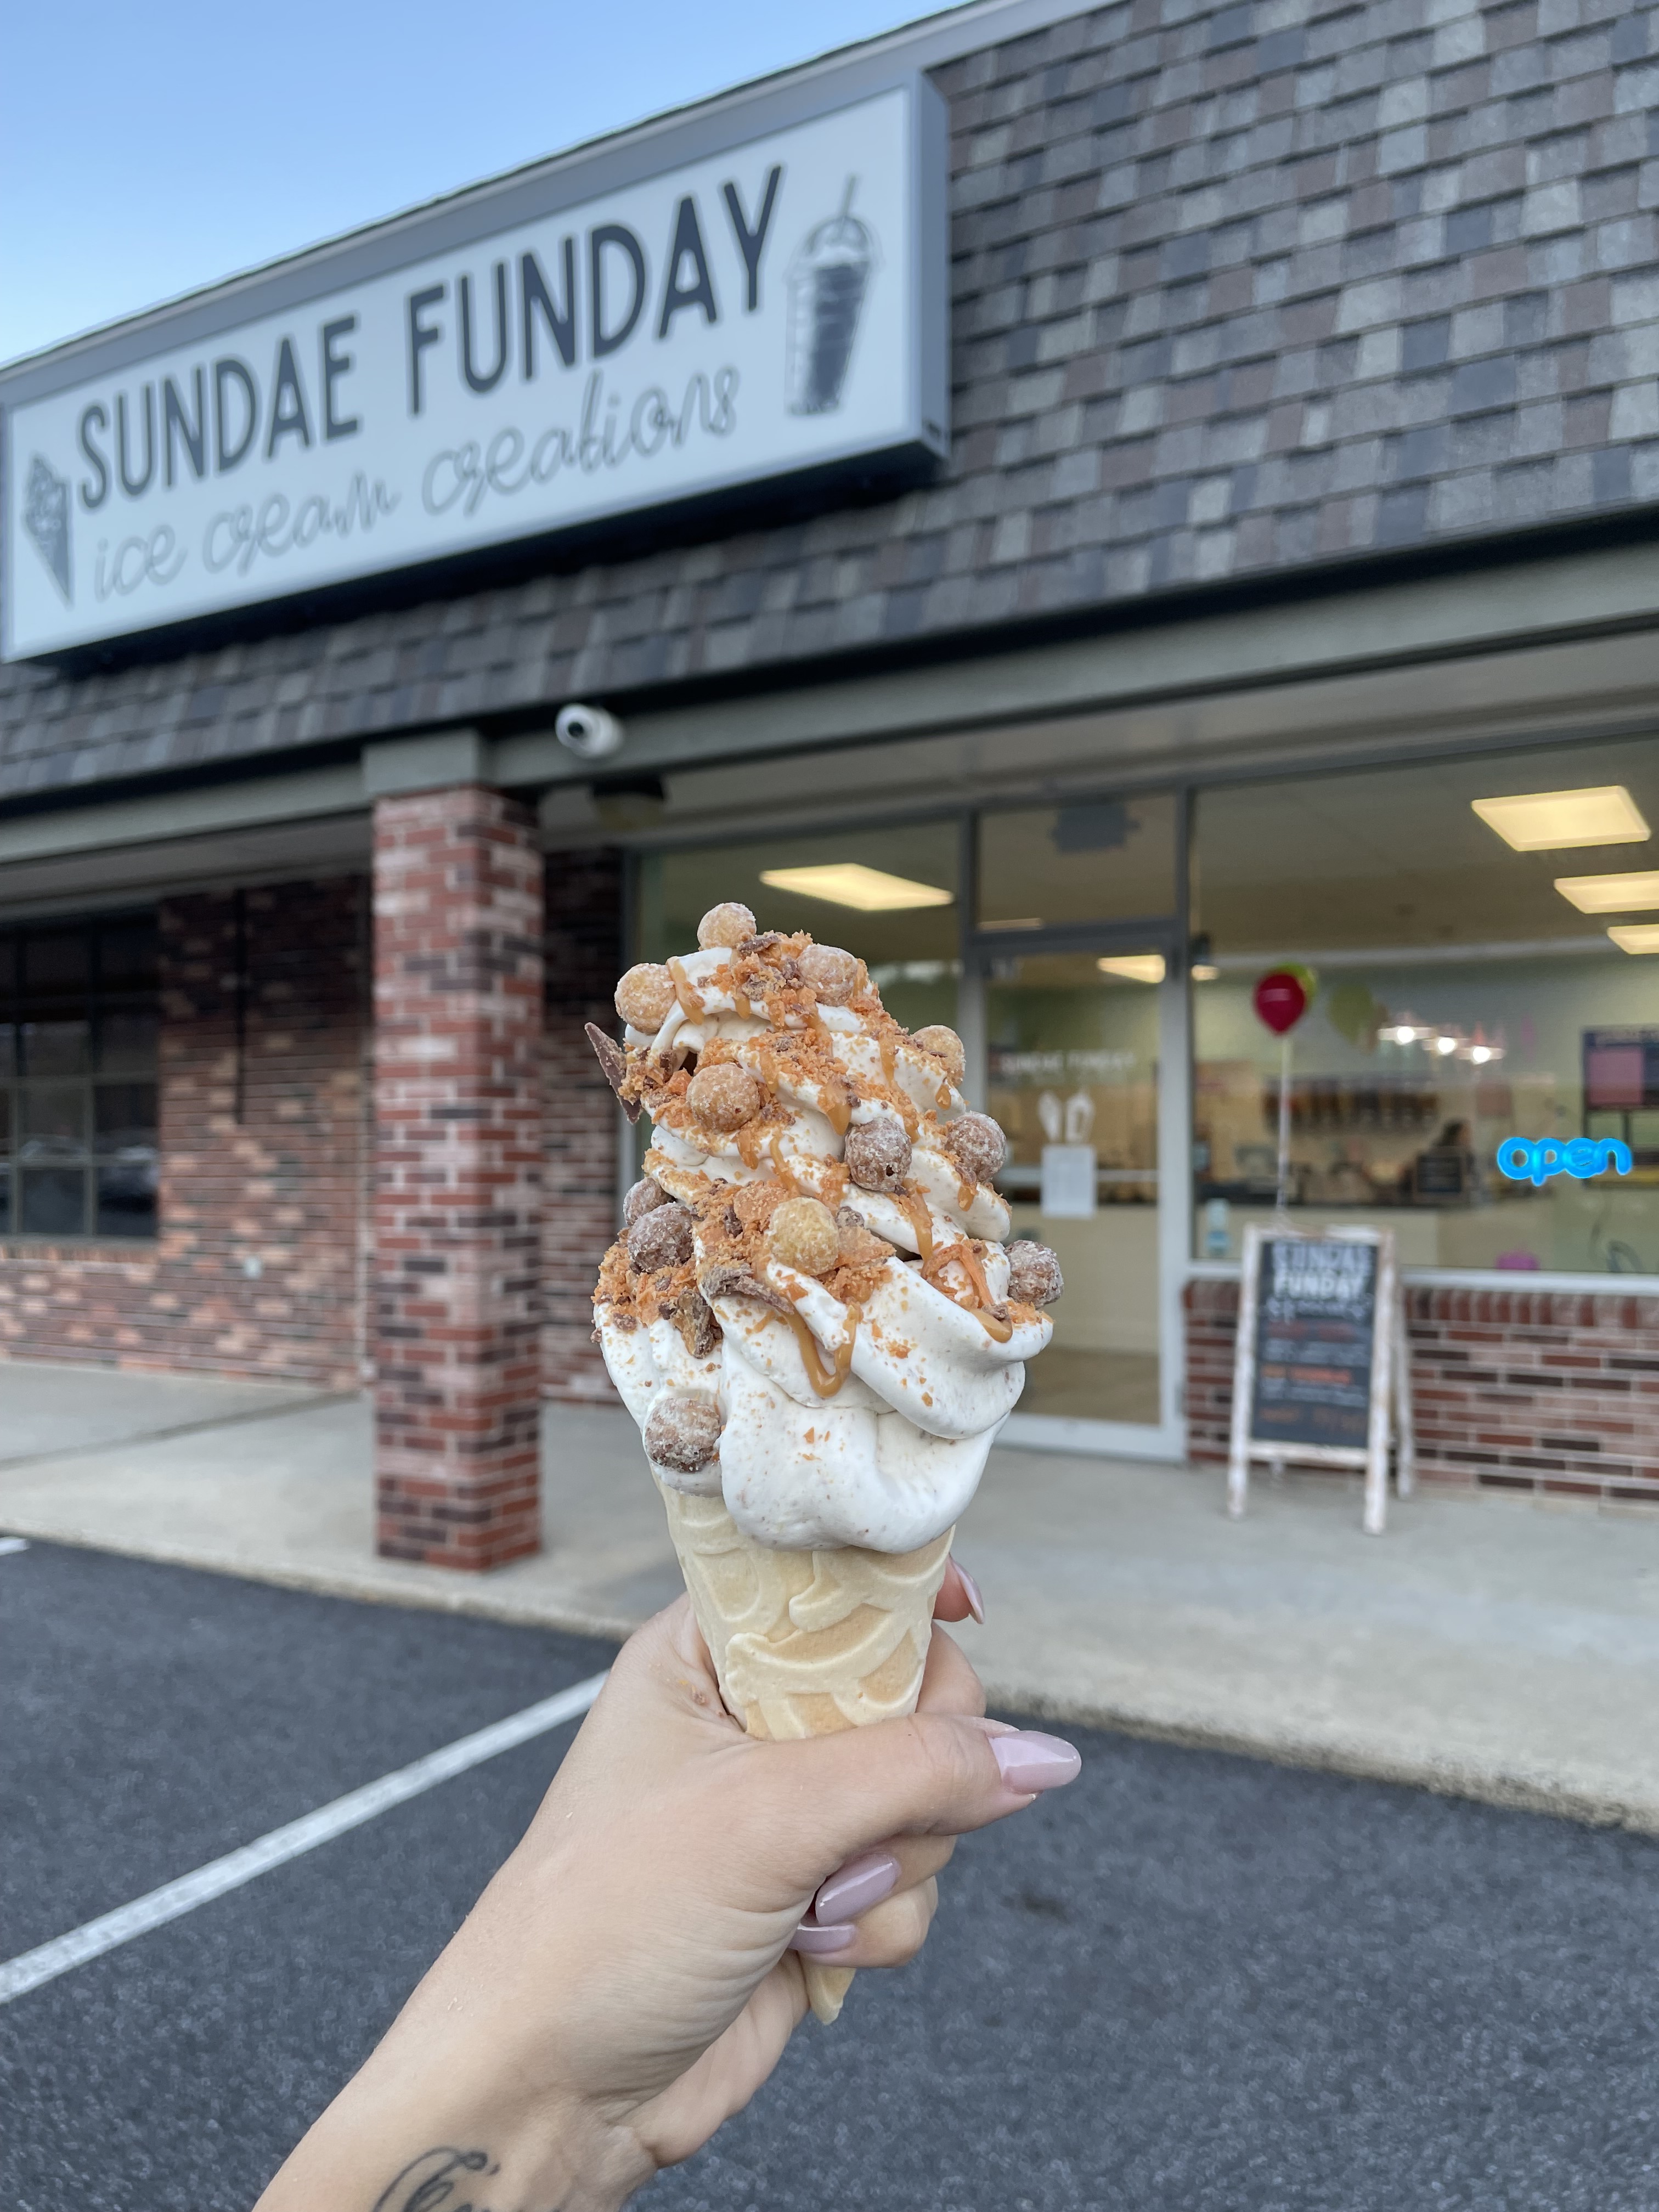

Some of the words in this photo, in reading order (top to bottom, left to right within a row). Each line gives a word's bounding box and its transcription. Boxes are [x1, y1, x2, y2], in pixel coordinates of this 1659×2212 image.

[81, 315, 359, 508] SUNDAE
[409, 164, 782, 415] FUNDAY
[94, 524, 188, 603] ice
[202, 471, 402, 577] cream
[422, 365, 740, 517] creations
[1497, 1137, 1633, 1187] open
